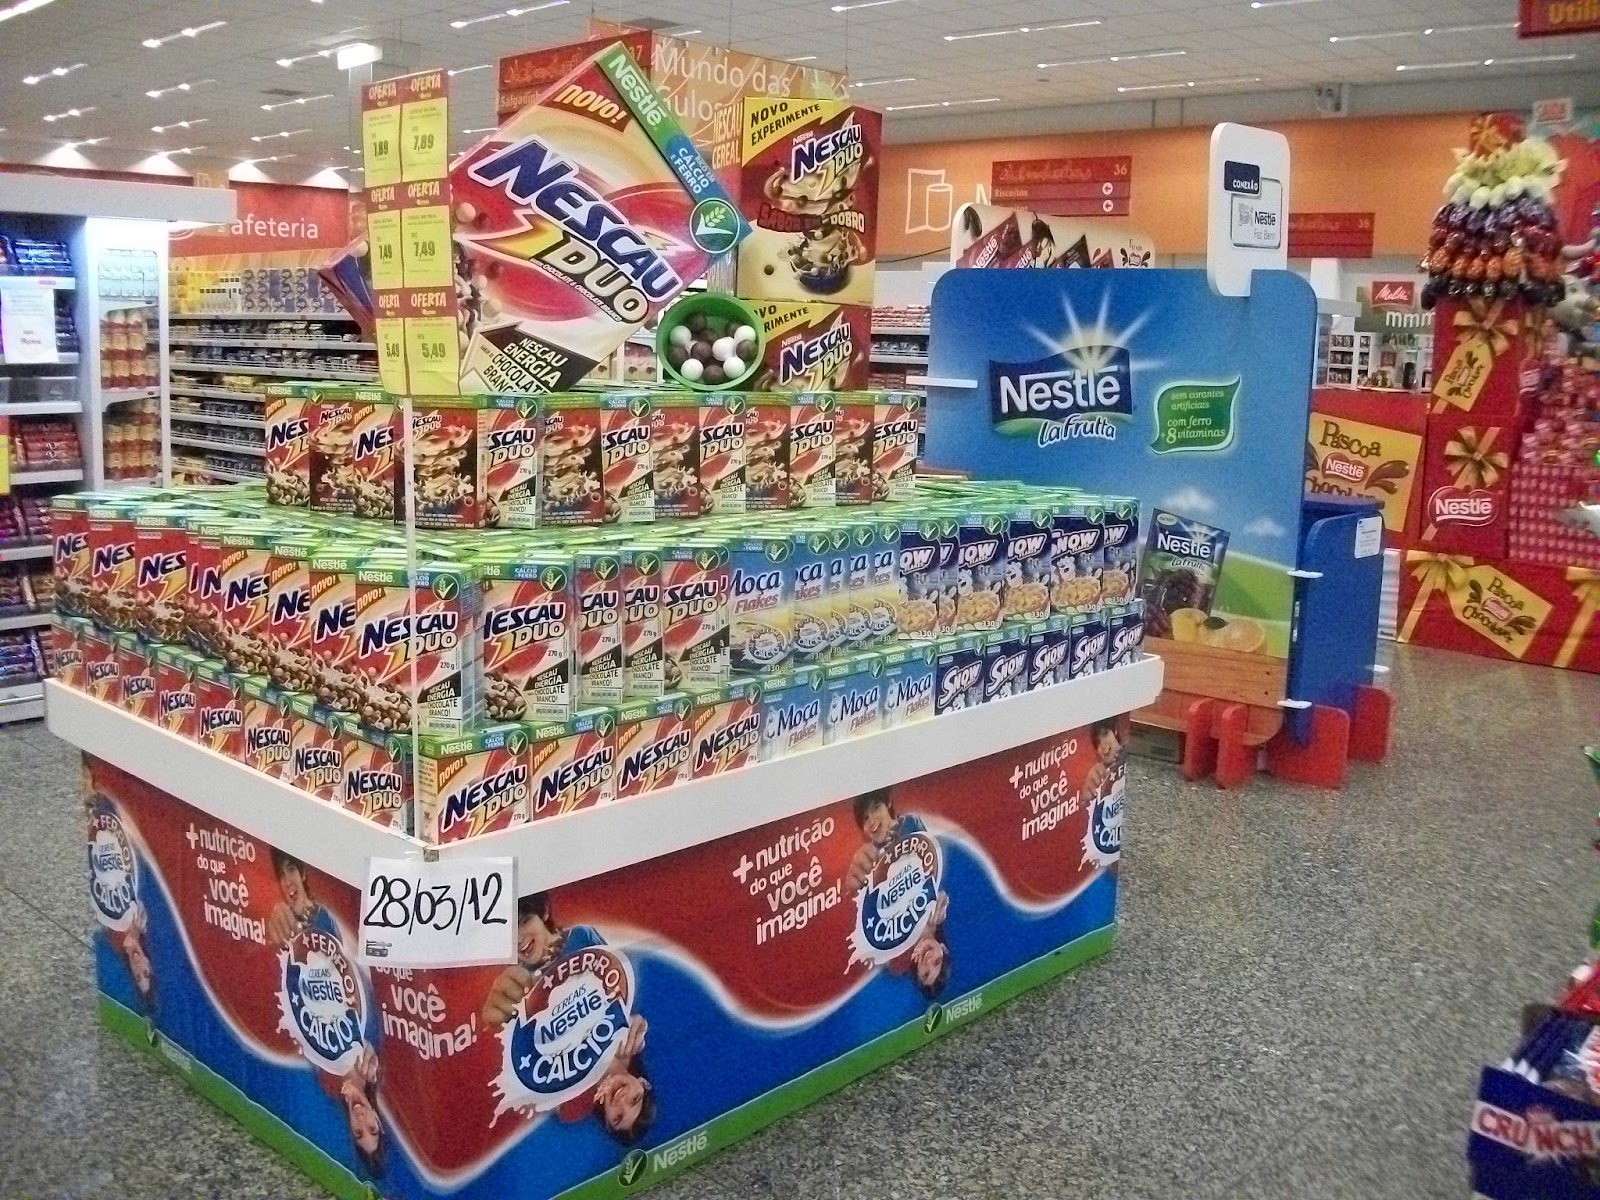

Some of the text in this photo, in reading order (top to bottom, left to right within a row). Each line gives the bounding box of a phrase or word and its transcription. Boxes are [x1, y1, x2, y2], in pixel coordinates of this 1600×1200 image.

[410, 74, 441, 92] OFERTA
[653, 43, 791, 97] Mundo das
[369, 82, 397, 100] OFERTA
[713, 102, 743, 144] NESCAU
[750, 102, 789, 128] NOVO
[751, 103, 821, 147] EXPERIMENTE
[413, 134, 434, 151] 7,89
[712, 140, 741, 170] CEREAL
[792, 124, 861, 183] NESCAU
[677, 145, 712, 189] CÁLCIO
[836, 142, 864, 174] DUO
[1113, 164, 1127, 176] 36
[408, 181, 440, 198] OFERTA
[674, 158, 703, 195] FERRO
[371, 186, 395, 203] OFERTA
[231, 213, 319, 239] afeteria
[471, 137, 682, 300] NESCAU
[830, 210, 865, 233] DOBRO
[541, 231, 649, 323] DUO
[411, 292, 447, 307] OFERTA
[421, 342, 447, 358] 5,49
[520, 337, 568, 369] NESCAU
[780, 323, 850, 386] NESCAU
[824, 340, 853, 373] DUO
[484, 365, 517, 392] BRANC
[492, 353, 549, 393] CHOCOLAT
[503, 342, 562, 389] ENERGIA
[1171, 389, 1224, 400] sem corantes
[1171, 400, 1210, 411] artificiais
[1167, 415, 1212, 429] com ferro
[1177, 427, 1226, 440] vitaminas
[493, 444, 535, 466] DUO
[610, 442, 651, 465] DUO
[705, 437, 744, 460] DUO
[798, 433, 835, 455] DUO
[884, 433, 918, 452] DUO
[670, 598, 719, 625] DUO
[734, 594, 780, 614] Flakes
[1031, 611, 1044, 619] 330
[514, 622, 566, 648] DUO
[918, 630, 932, 638] 330
[86, 661, 120, 687] NESCAU
[440, 661, 451, 669] 270
[122, 676, 156, 701] NESCAU
[427, 698, 458, 709] CHOCOLATE
[534, 685, 566, 697] CHOCOLATE
[840, 685, 880, 721] Moça
[896, 673, 933, 708] Moça
[159, 690, 197, 720] NESCAU
[777, 700, 819, 737] Moça
[851, 707, 876, 731] Flakes
[200, 707, 242, 738] NESCAU
[788, 720, 817, 748] Flakes
[247, 727, 291, 758] NESCAU
[266, 747, 291, 764] DUO
[695, 713, 760, 773] NESCAU
[728, 731, 759, 761] DUO
[295, 748, 342, 778] NESCAU
[619, 729, 691, 791] NESCAU
[654, 746, 690, 780] DUO
[313, 768, 342, 789] DUO
[347, 770, 402, 801] NESCAU
[536, 746, 614, 812] NESCAU
[574, 764, 613, 802] DUO
[1019, 774, 1049, 800] do que
[1030, 769, 1068, 814] você
[371, 792, 402, 813] DUO
[442, 764, 528, 833] NESCAU
[484, 784, 527, 823] DUO
[1021, 789, 1080, 841] imagina!
[197, 853, 226, 875] do que
[894, 837, 934, 867] FERRO
[209, 873, 249, 907] você
[750, 863, 793, 896] do que
[767, 856, 823, 912] você
[363, 871, 508, 936] 28/03/12
[756, 877, 841, 945] imagina!
[203, 894, 266, 946] imagina!
[310, 933, 355, 994] FERRO
[556, 952, 620, 988] FERRO
[391, 983, 446, 1023] você
[551, 984, 587, 1017] CEREAIS
[382, 1003, 477, 1060] imagina!
[1478, 1108, 1595, 1153] CRUNCH
